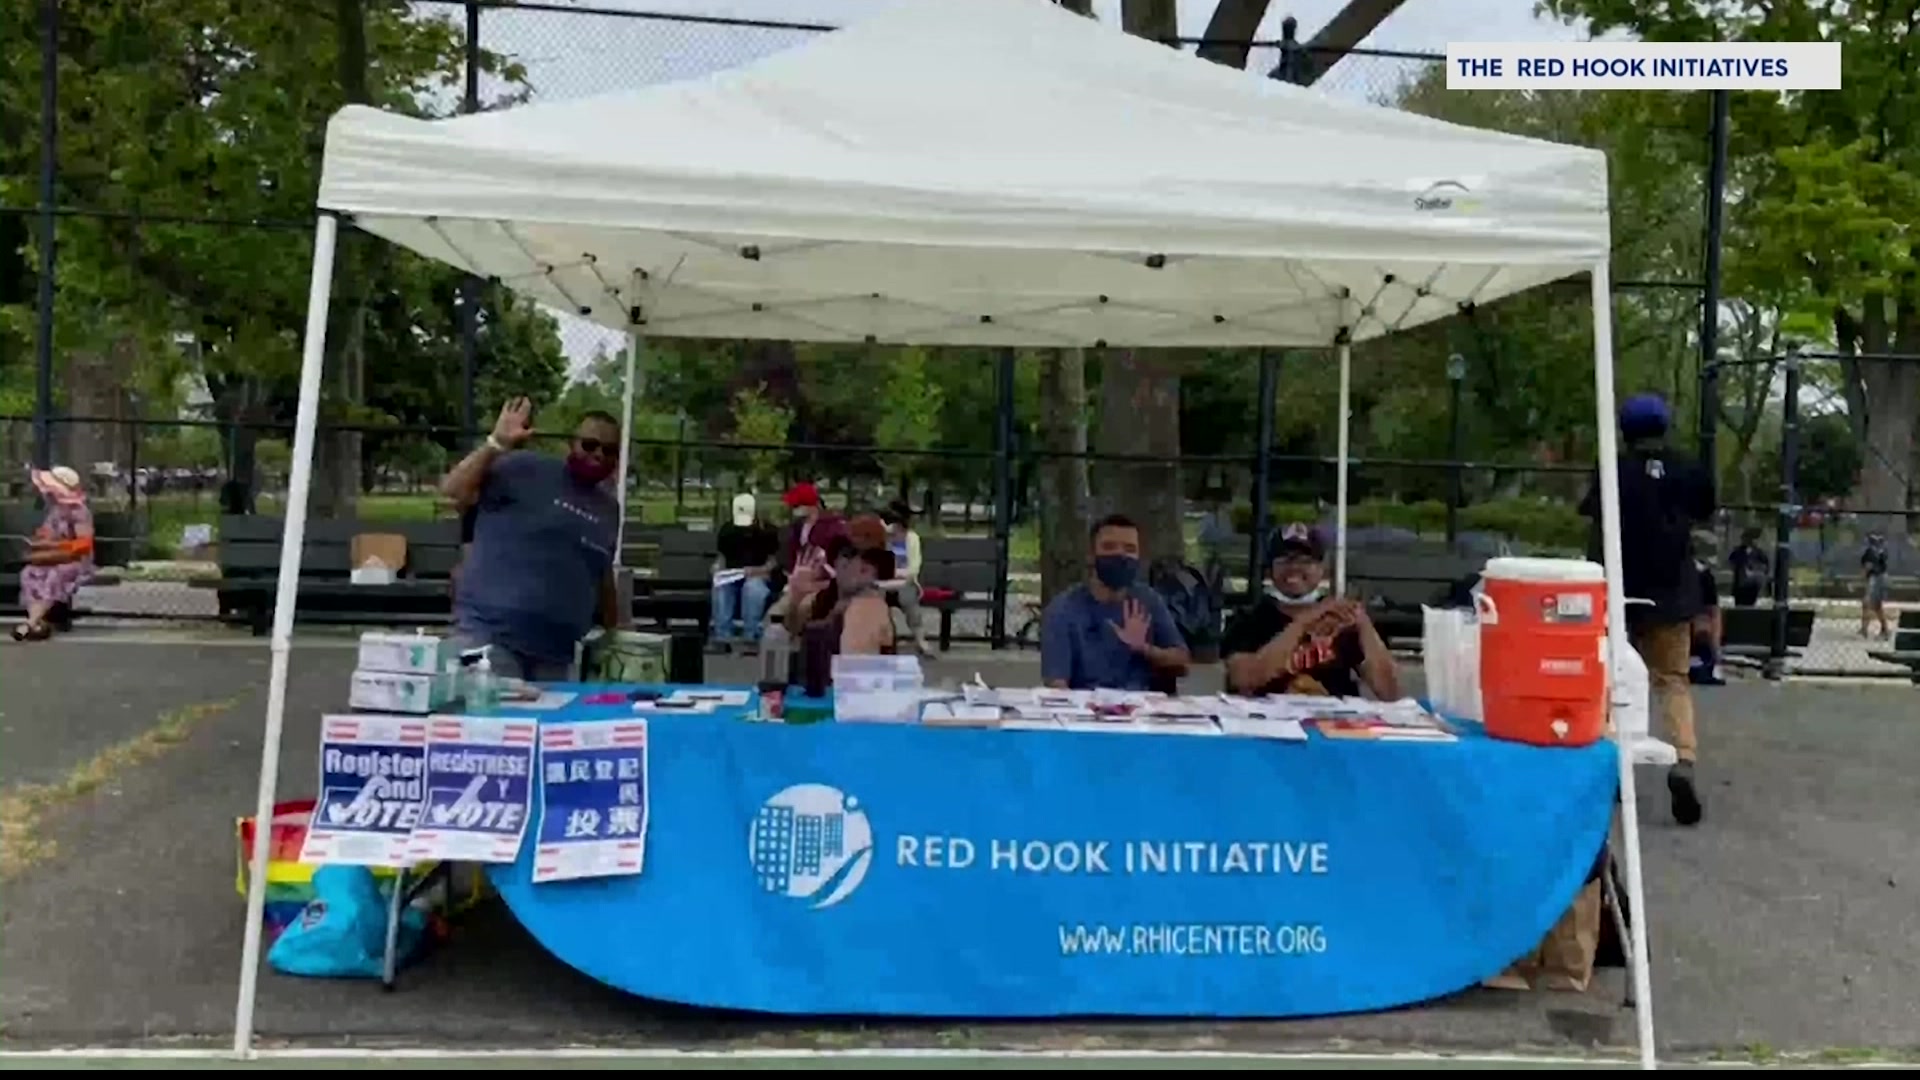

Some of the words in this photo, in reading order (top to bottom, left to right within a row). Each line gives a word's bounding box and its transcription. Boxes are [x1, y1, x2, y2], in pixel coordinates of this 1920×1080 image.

[325, 749, 424, 777] Register
[328, 776, 422, 828] VOTE
[376, 777, 421, 801] and
[431, 776, 525, 829] VOTE
[495, 777, 510, 799] Y
[564, 805, 643, 838] 投票
[896, 836, 975, 869] RED
[991, 839, 1110, 873] HOOK
[1125, 841, 1330, 874] INITIATIVE
[1058, 925, 1328, 956] WWW.RHICENTER.ORG
